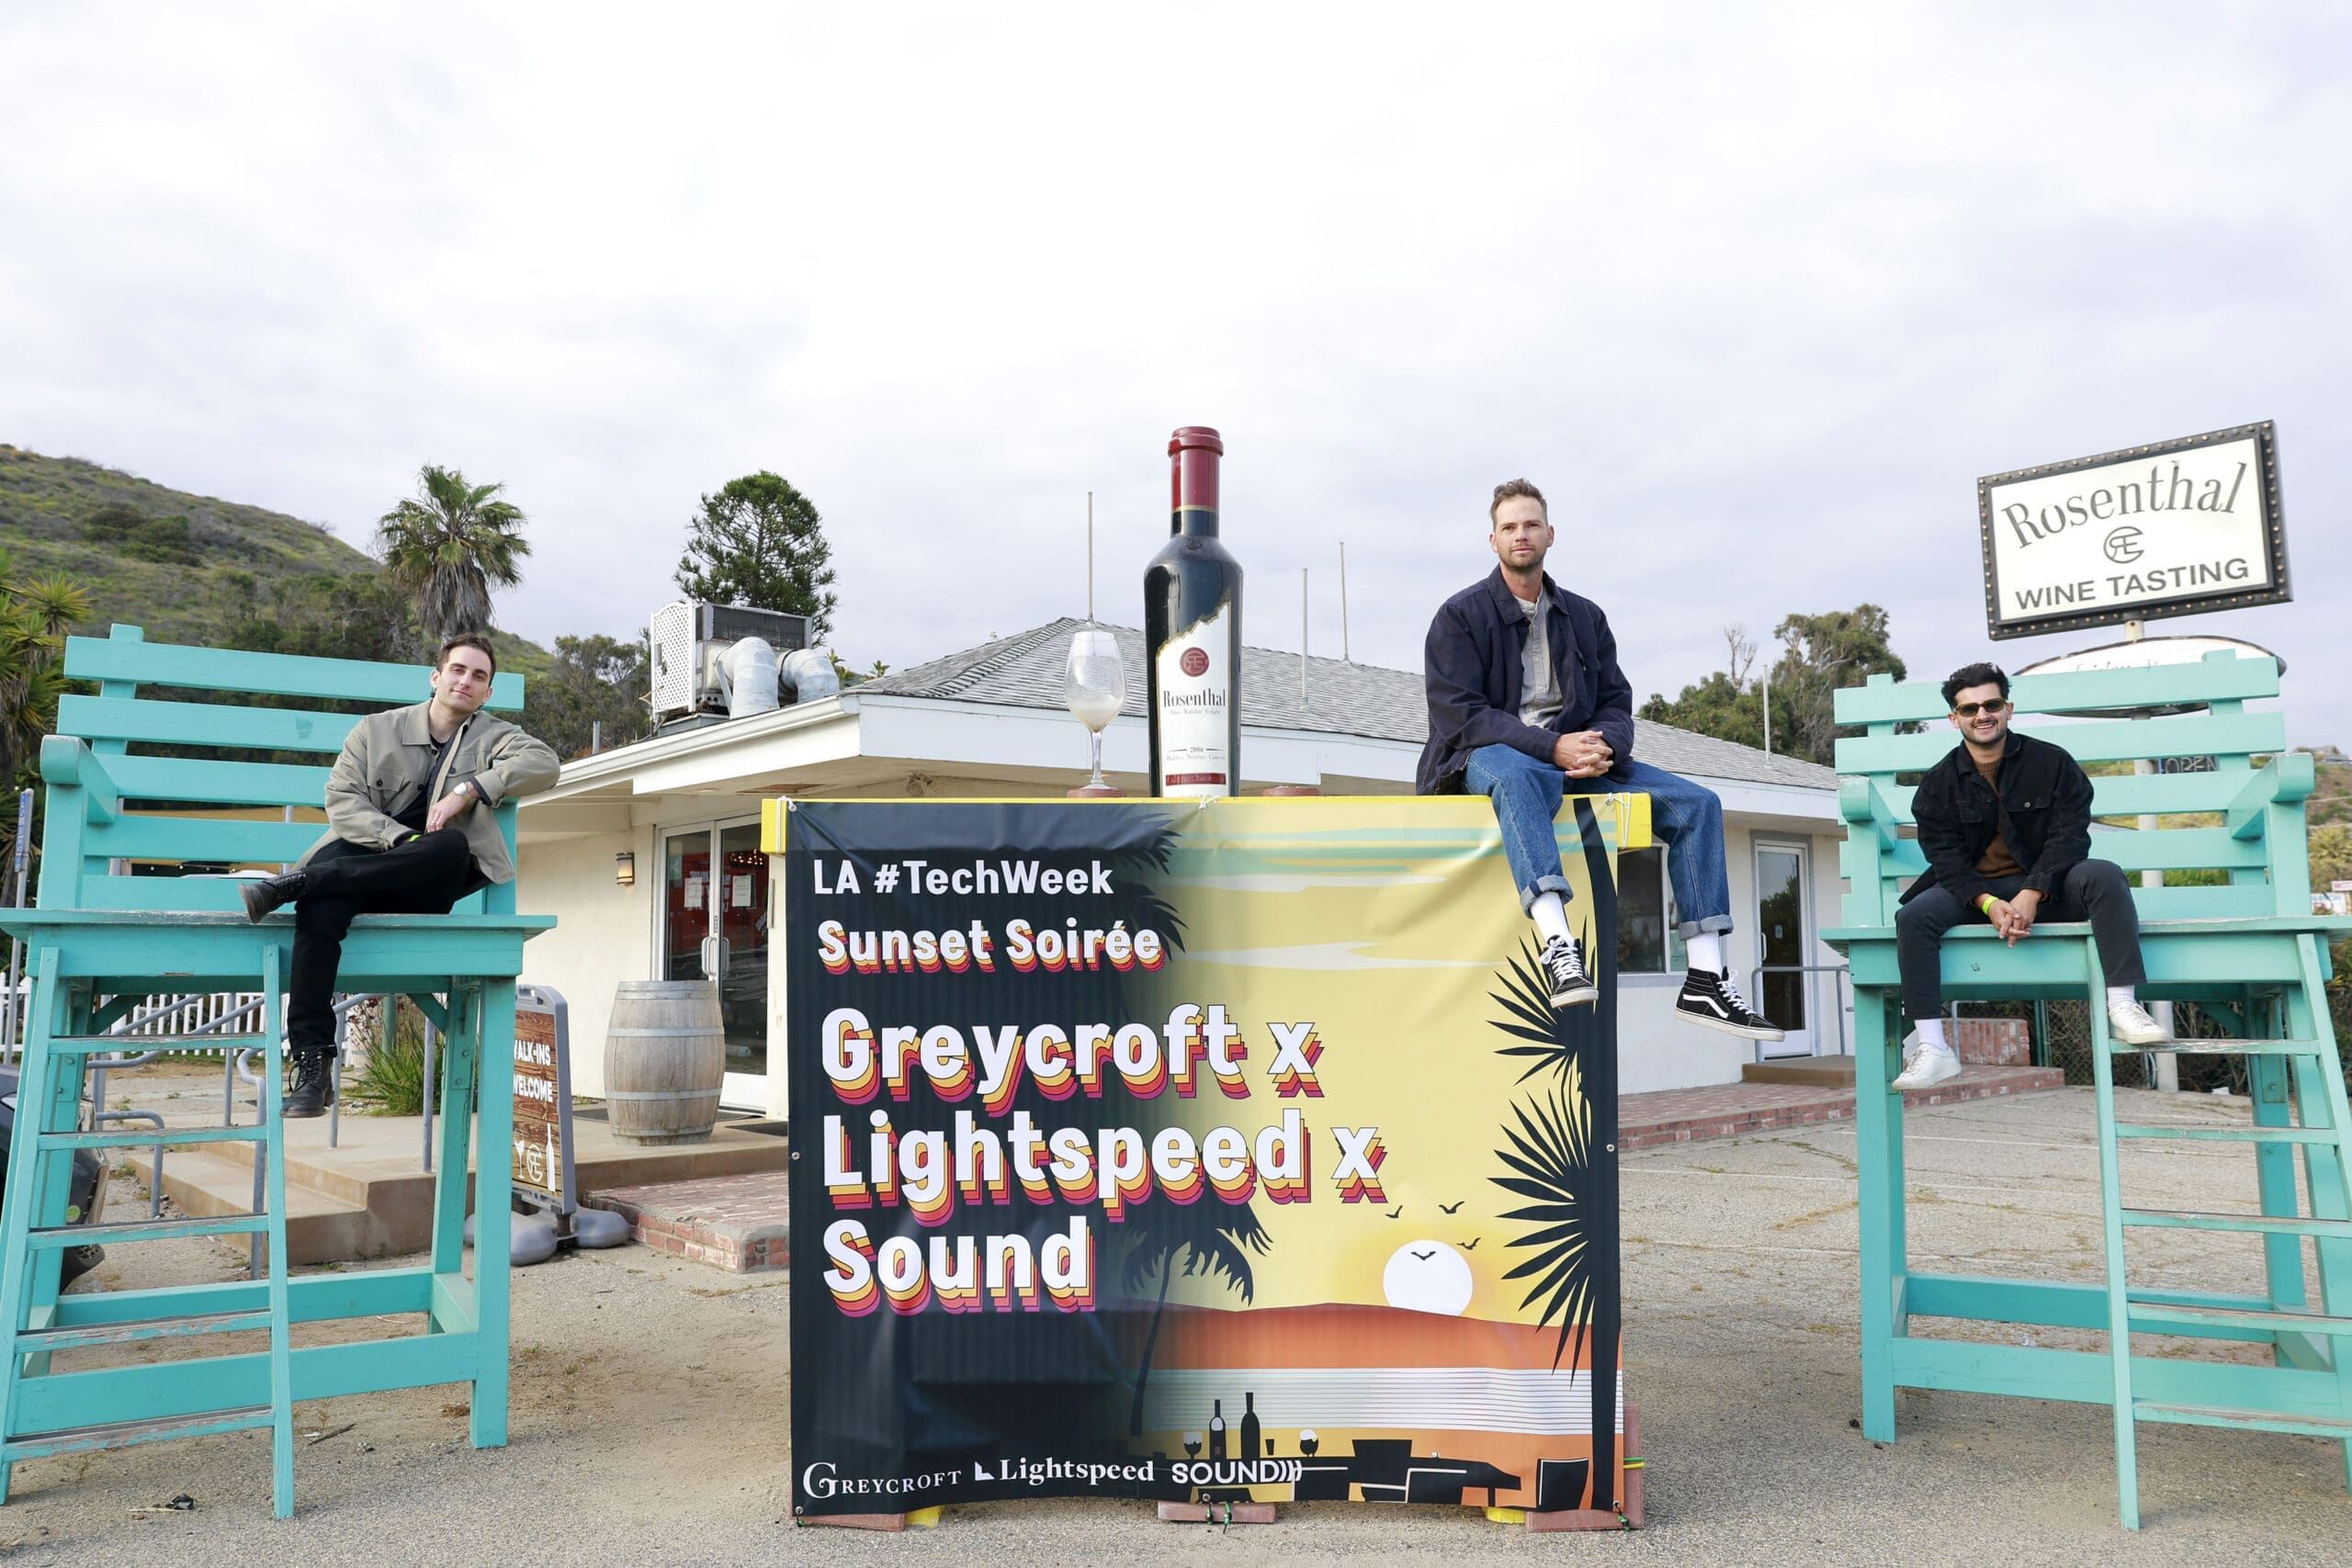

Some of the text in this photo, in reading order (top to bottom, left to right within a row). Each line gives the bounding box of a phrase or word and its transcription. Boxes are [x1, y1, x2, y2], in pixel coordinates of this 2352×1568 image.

[2001, 460, 2247, 549] Rosenthal
[2016, 558, 2249, 610] WINE TASTING
[1163, 687, 1227, 707] Rosenthal
[814, 859, 1114, 896] LA #TechWeek
[818, 918, 1165, 975] Sunset Soirée
[821, 1003, 1324, 1118] Greycroft x
[824, 1108, 1388, 1226] Lightspeed x
[823, 1215, 1096, 1317] Sound
[802, 1461, 962, 1499] GREYCROFT
[1000, 1457, 1155, 1486] Lightspeed
